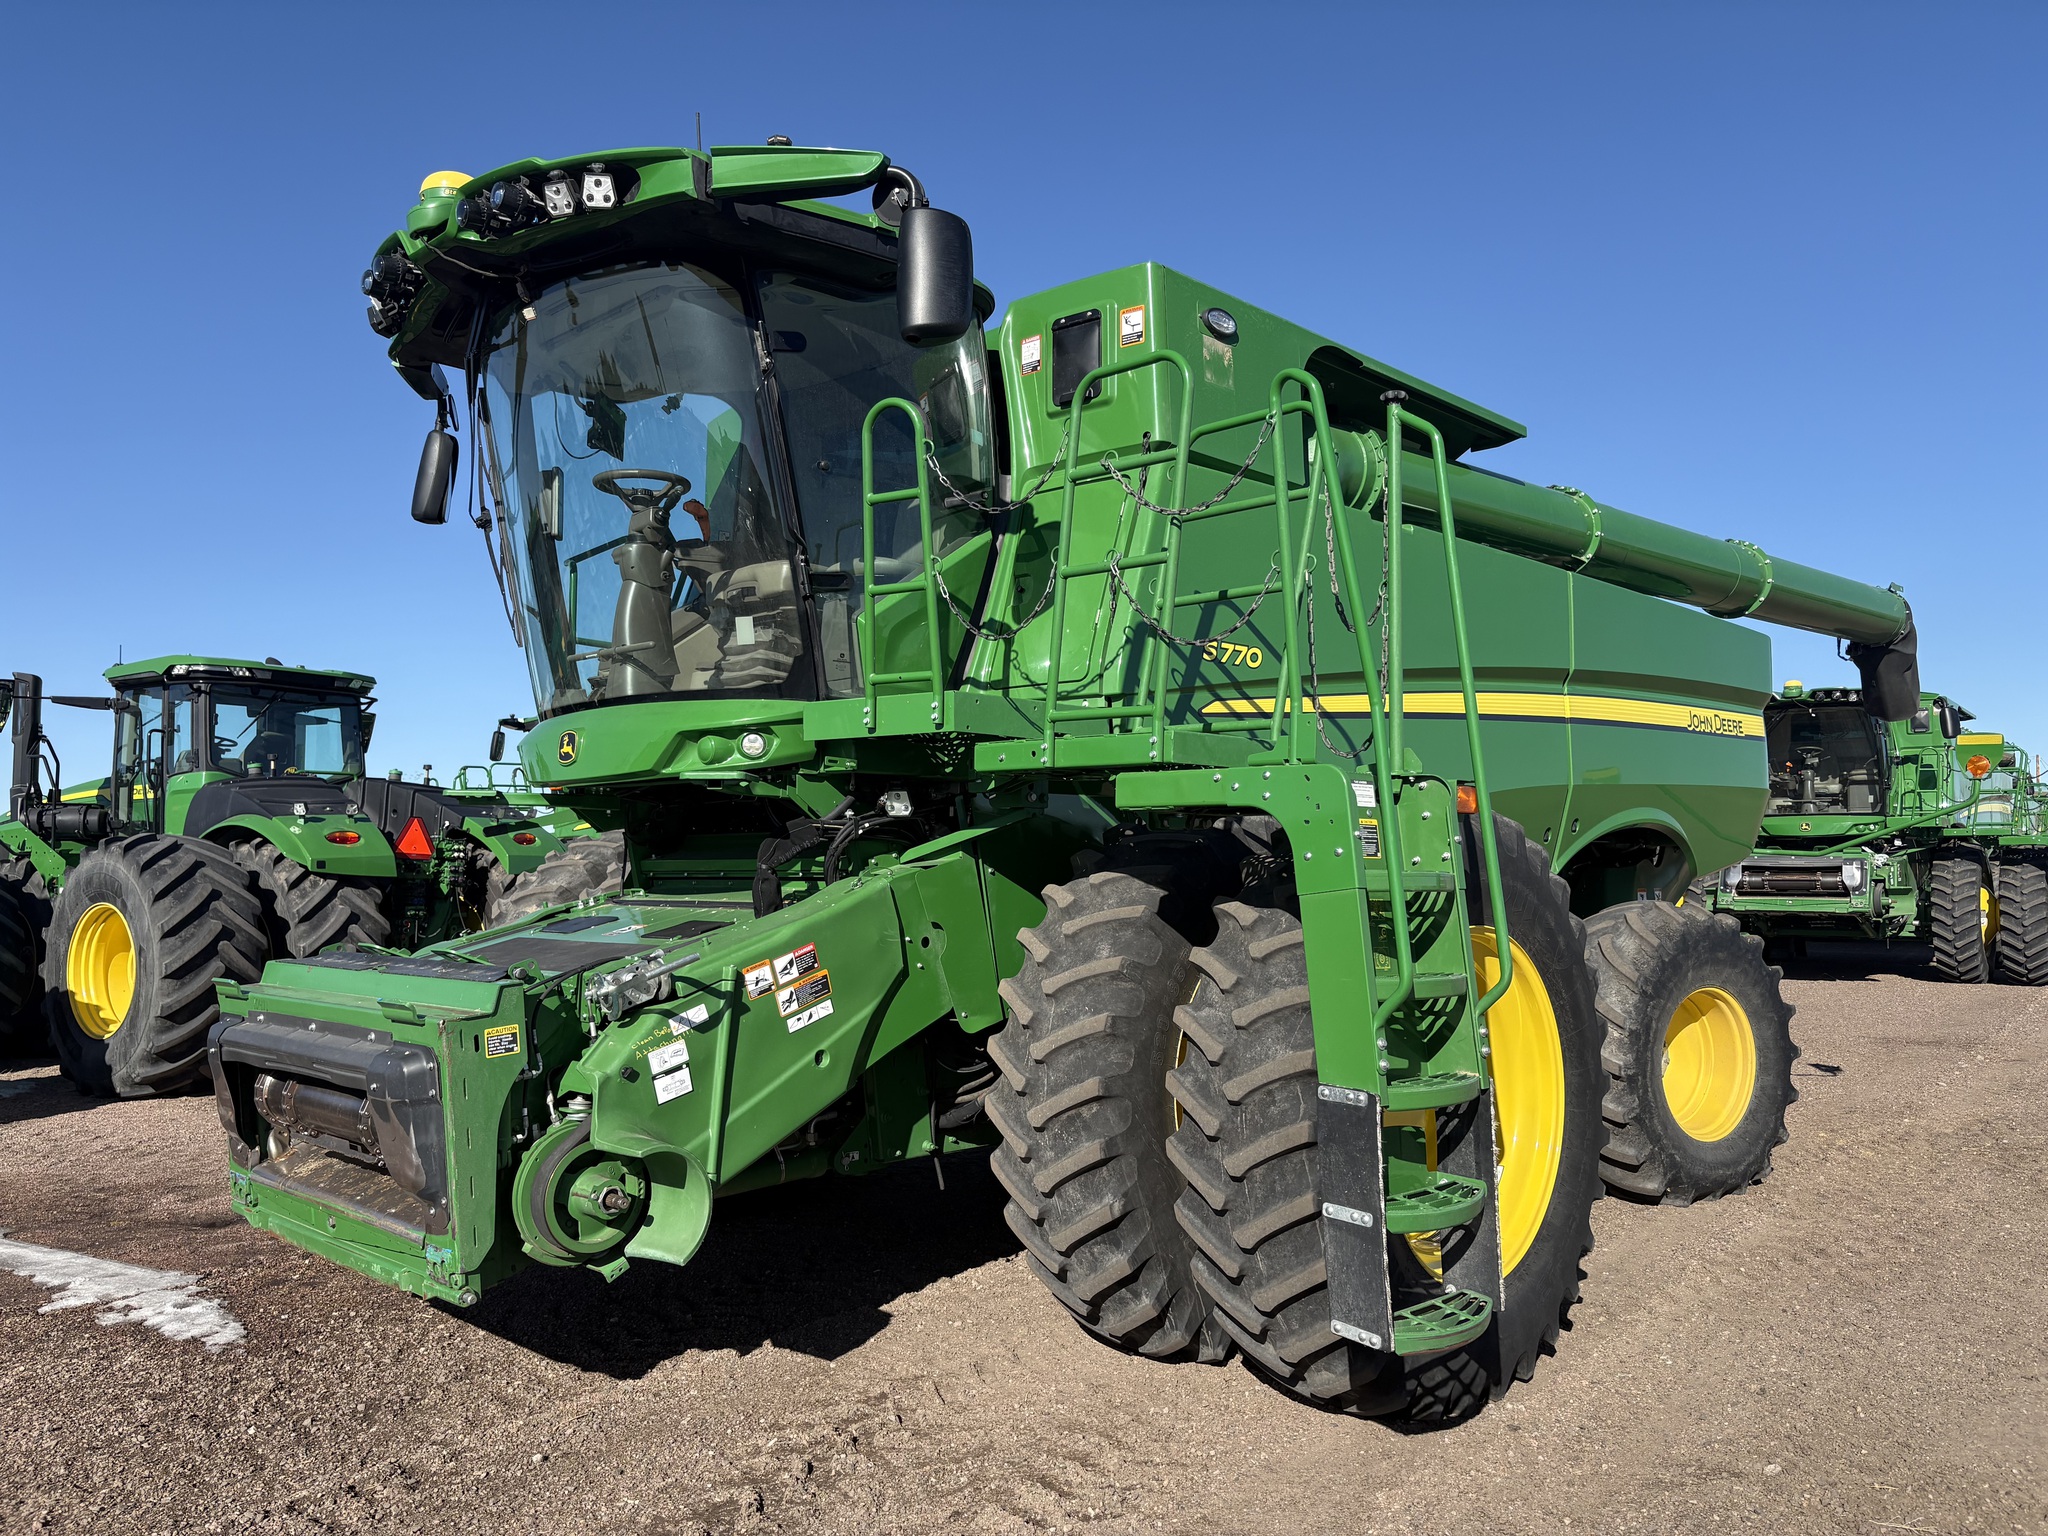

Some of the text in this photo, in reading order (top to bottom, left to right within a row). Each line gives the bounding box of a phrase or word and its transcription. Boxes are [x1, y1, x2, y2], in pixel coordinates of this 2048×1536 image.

[1202, 641, 1263, 669] S770
[1687, 710, 1744, 734] JOHN DEERE
[491, 1025, 518, 1035] CAUTION
